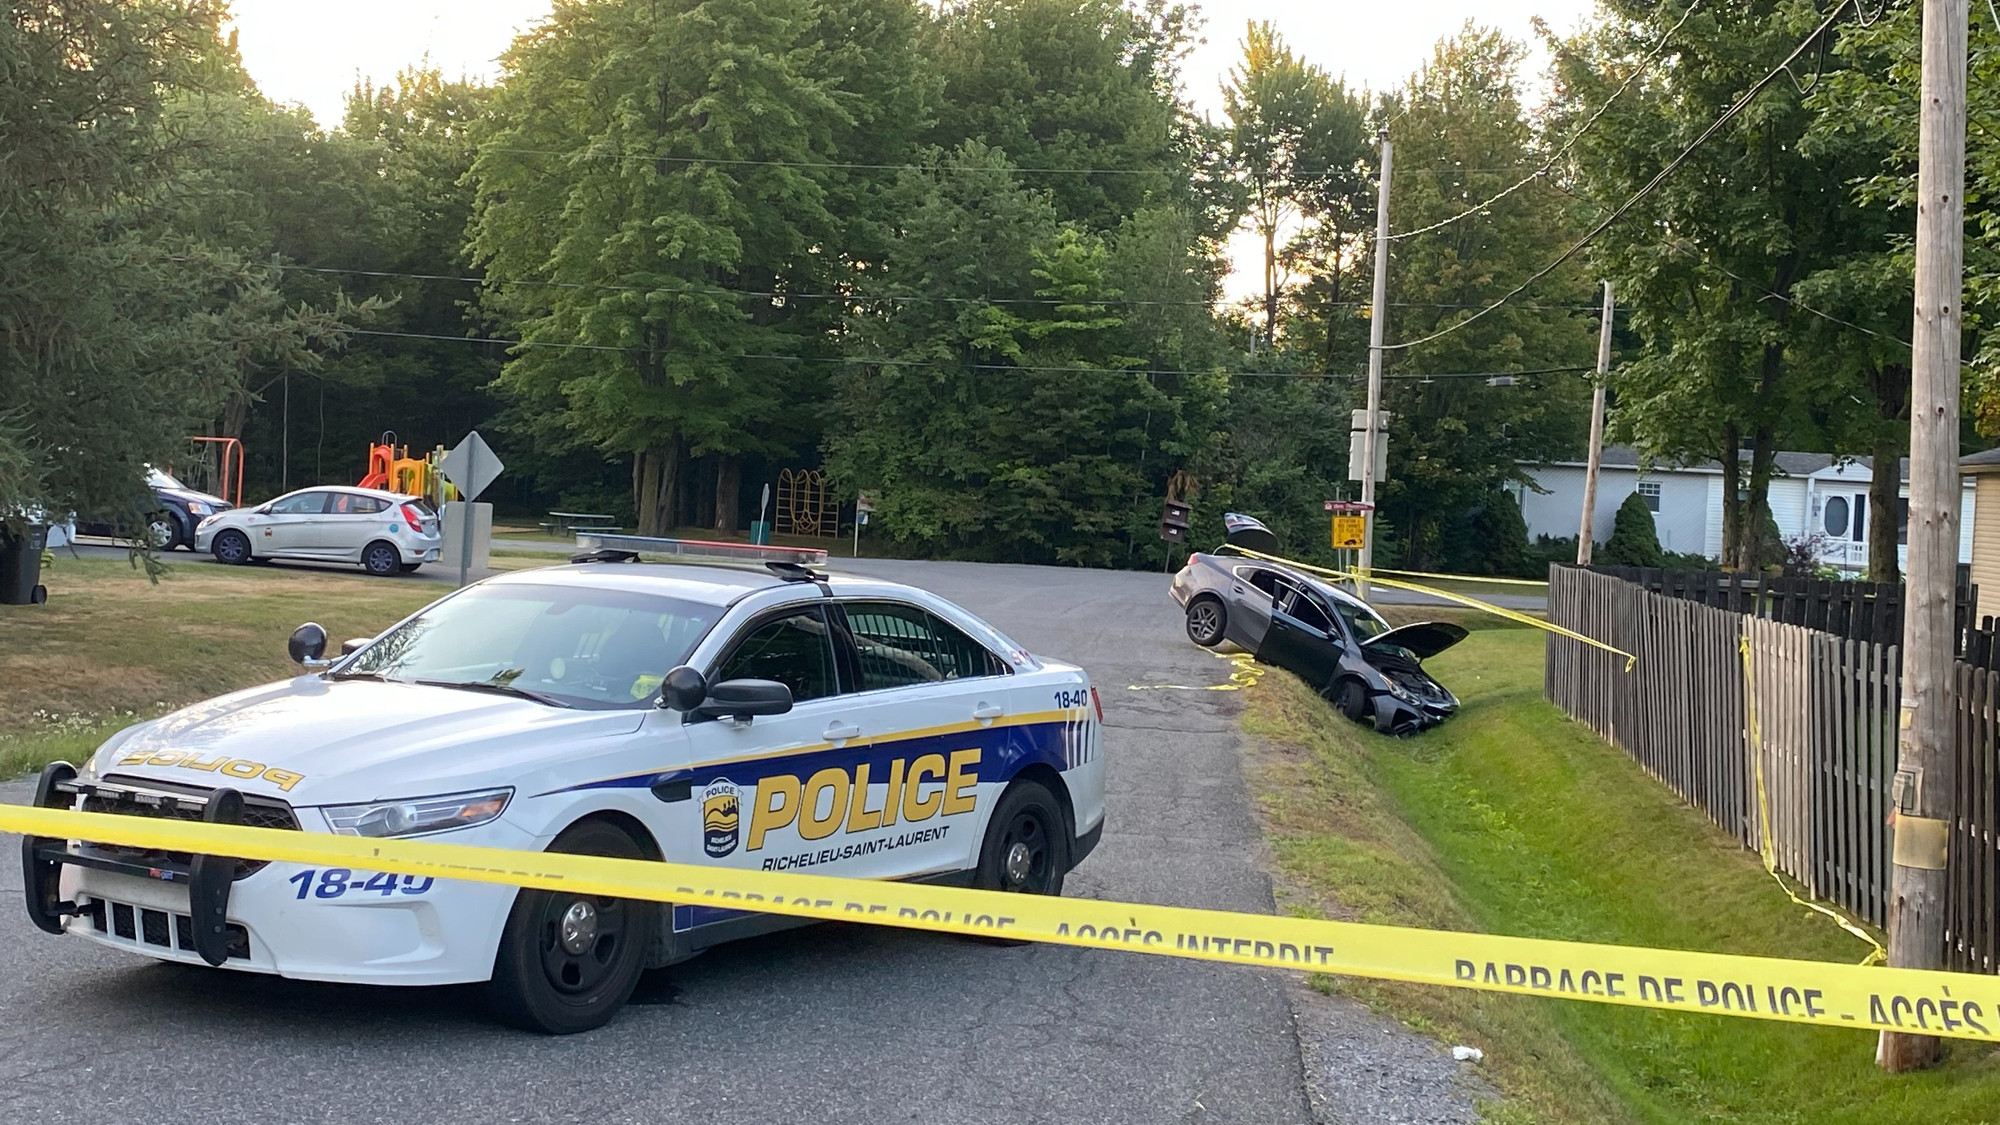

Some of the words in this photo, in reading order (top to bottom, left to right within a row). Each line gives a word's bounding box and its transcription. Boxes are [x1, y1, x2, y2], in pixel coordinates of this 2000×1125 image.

[1054, 689, 1088, 709] 18-40
[706, 785, 735, 799] POLICE
[746, 748, 982, 852] POLICE
[762, 826, 950, 872] RICHELIEU-SAINT-LAURENT
